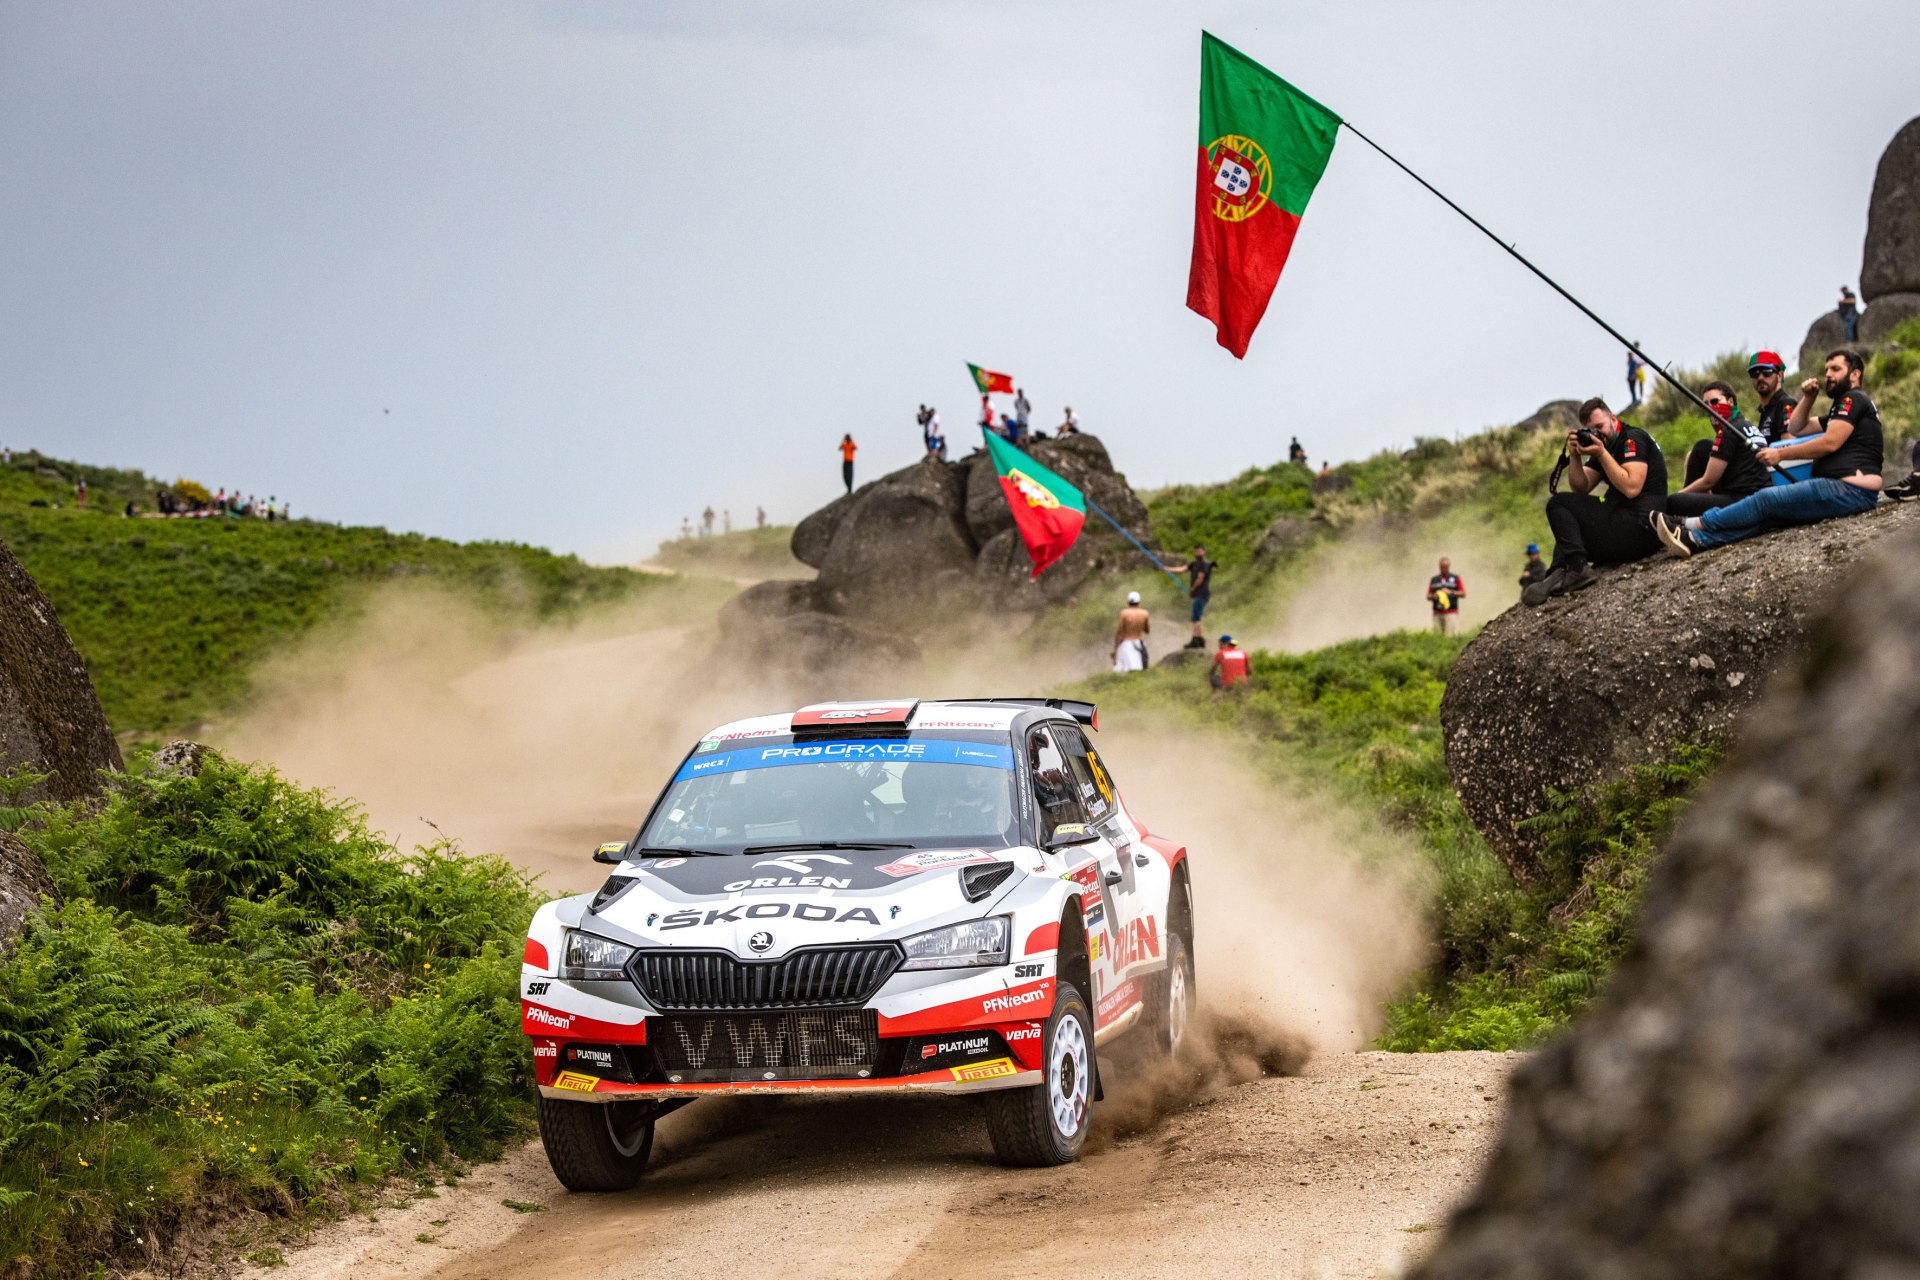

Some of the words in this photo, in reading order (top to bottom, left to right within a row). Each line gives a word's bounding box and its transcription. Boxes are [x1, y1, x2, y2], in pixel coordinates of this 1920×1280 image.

[693, 759, 725, 771] WRC2
[723, 876, 853, 892] ORLEN
[659, 903, 882, 931] ŠKODA
[1113, 914, 1160, 976] ORLEN
[1014, 963, 1045, 978] SRT
[526, 982, 552, 996] SRT
[1006, 1027, 1042, 1041] verva
[576, 1049, 612, 1062] PLATINUM
[957, 1061, 1011, 1080] PIRELLI
[558, 1074, 595, 1092] PIRELLI
